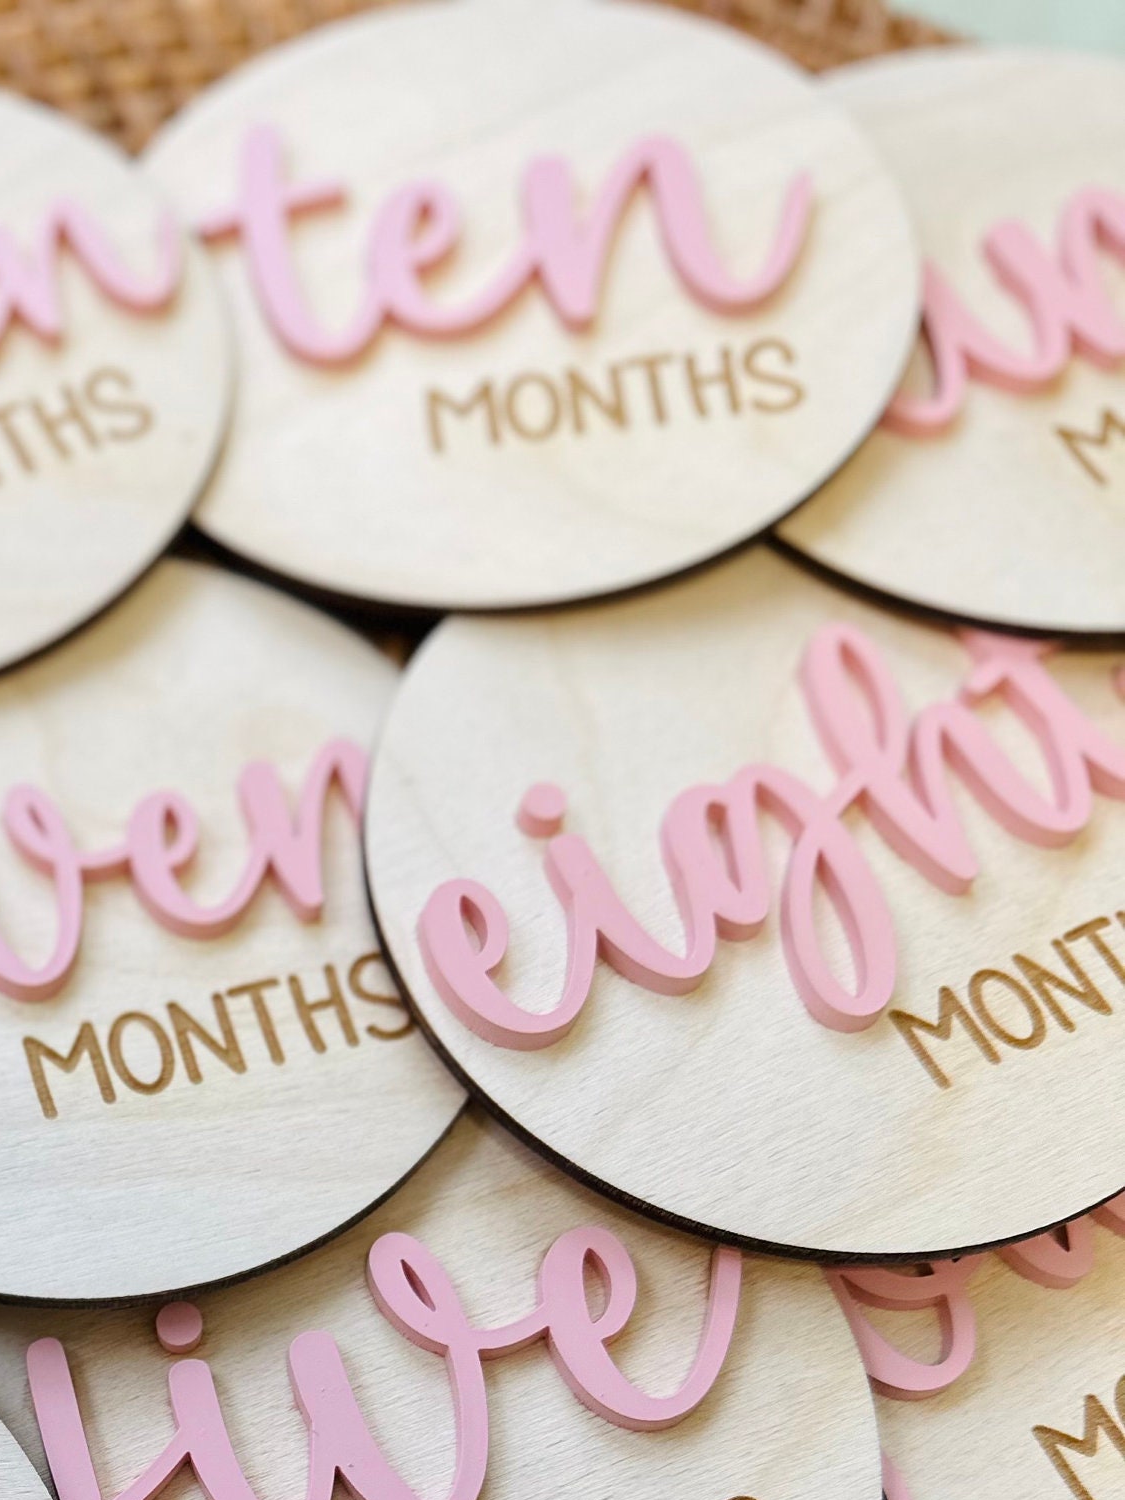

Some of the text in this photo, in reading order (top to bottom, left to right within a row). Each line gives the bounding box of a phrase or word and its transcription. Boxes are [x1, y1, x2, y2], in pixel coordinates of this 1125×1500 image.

[200, 122, 815, 370] ten
[423, 338, 807, 456] MONTHS
[22, 950, 416, 1120] MONTHS
[887, 910, 1125, 1090] MONT
